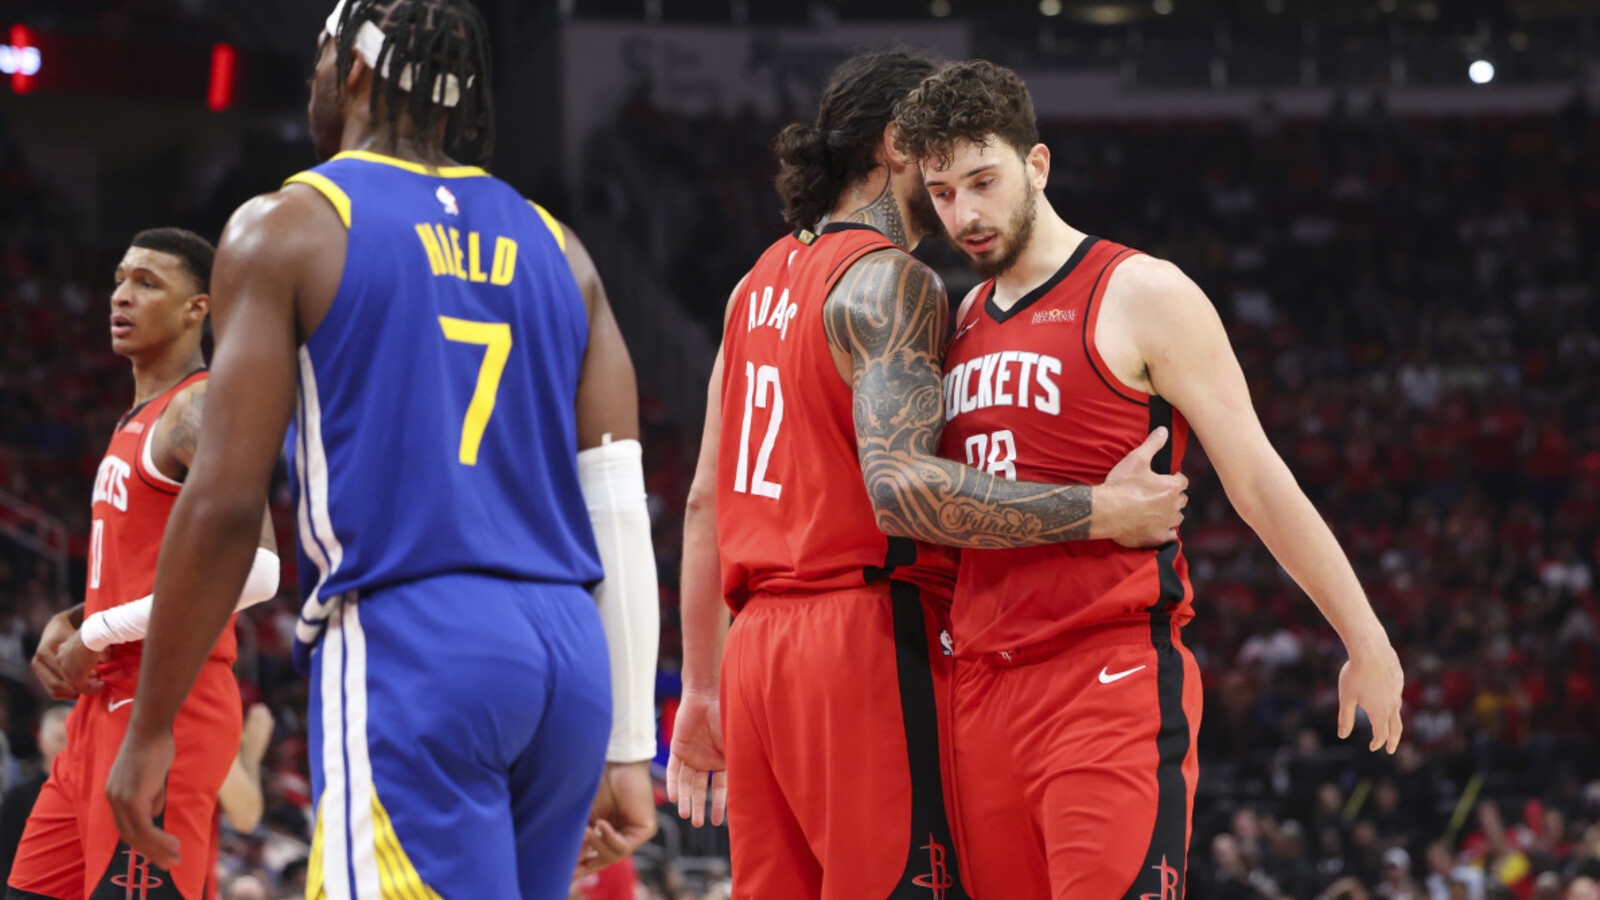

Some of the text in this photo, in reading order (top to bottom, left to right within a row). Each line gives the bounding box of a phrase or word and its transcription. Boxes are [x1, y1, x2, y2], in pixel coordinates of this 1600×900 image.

[414, 222, 518, 286] HIELD
[437, 315, 513, 466] 7
[734, 360, 784, 499] 12
[942, 351, 1062, 422] OCKETS
